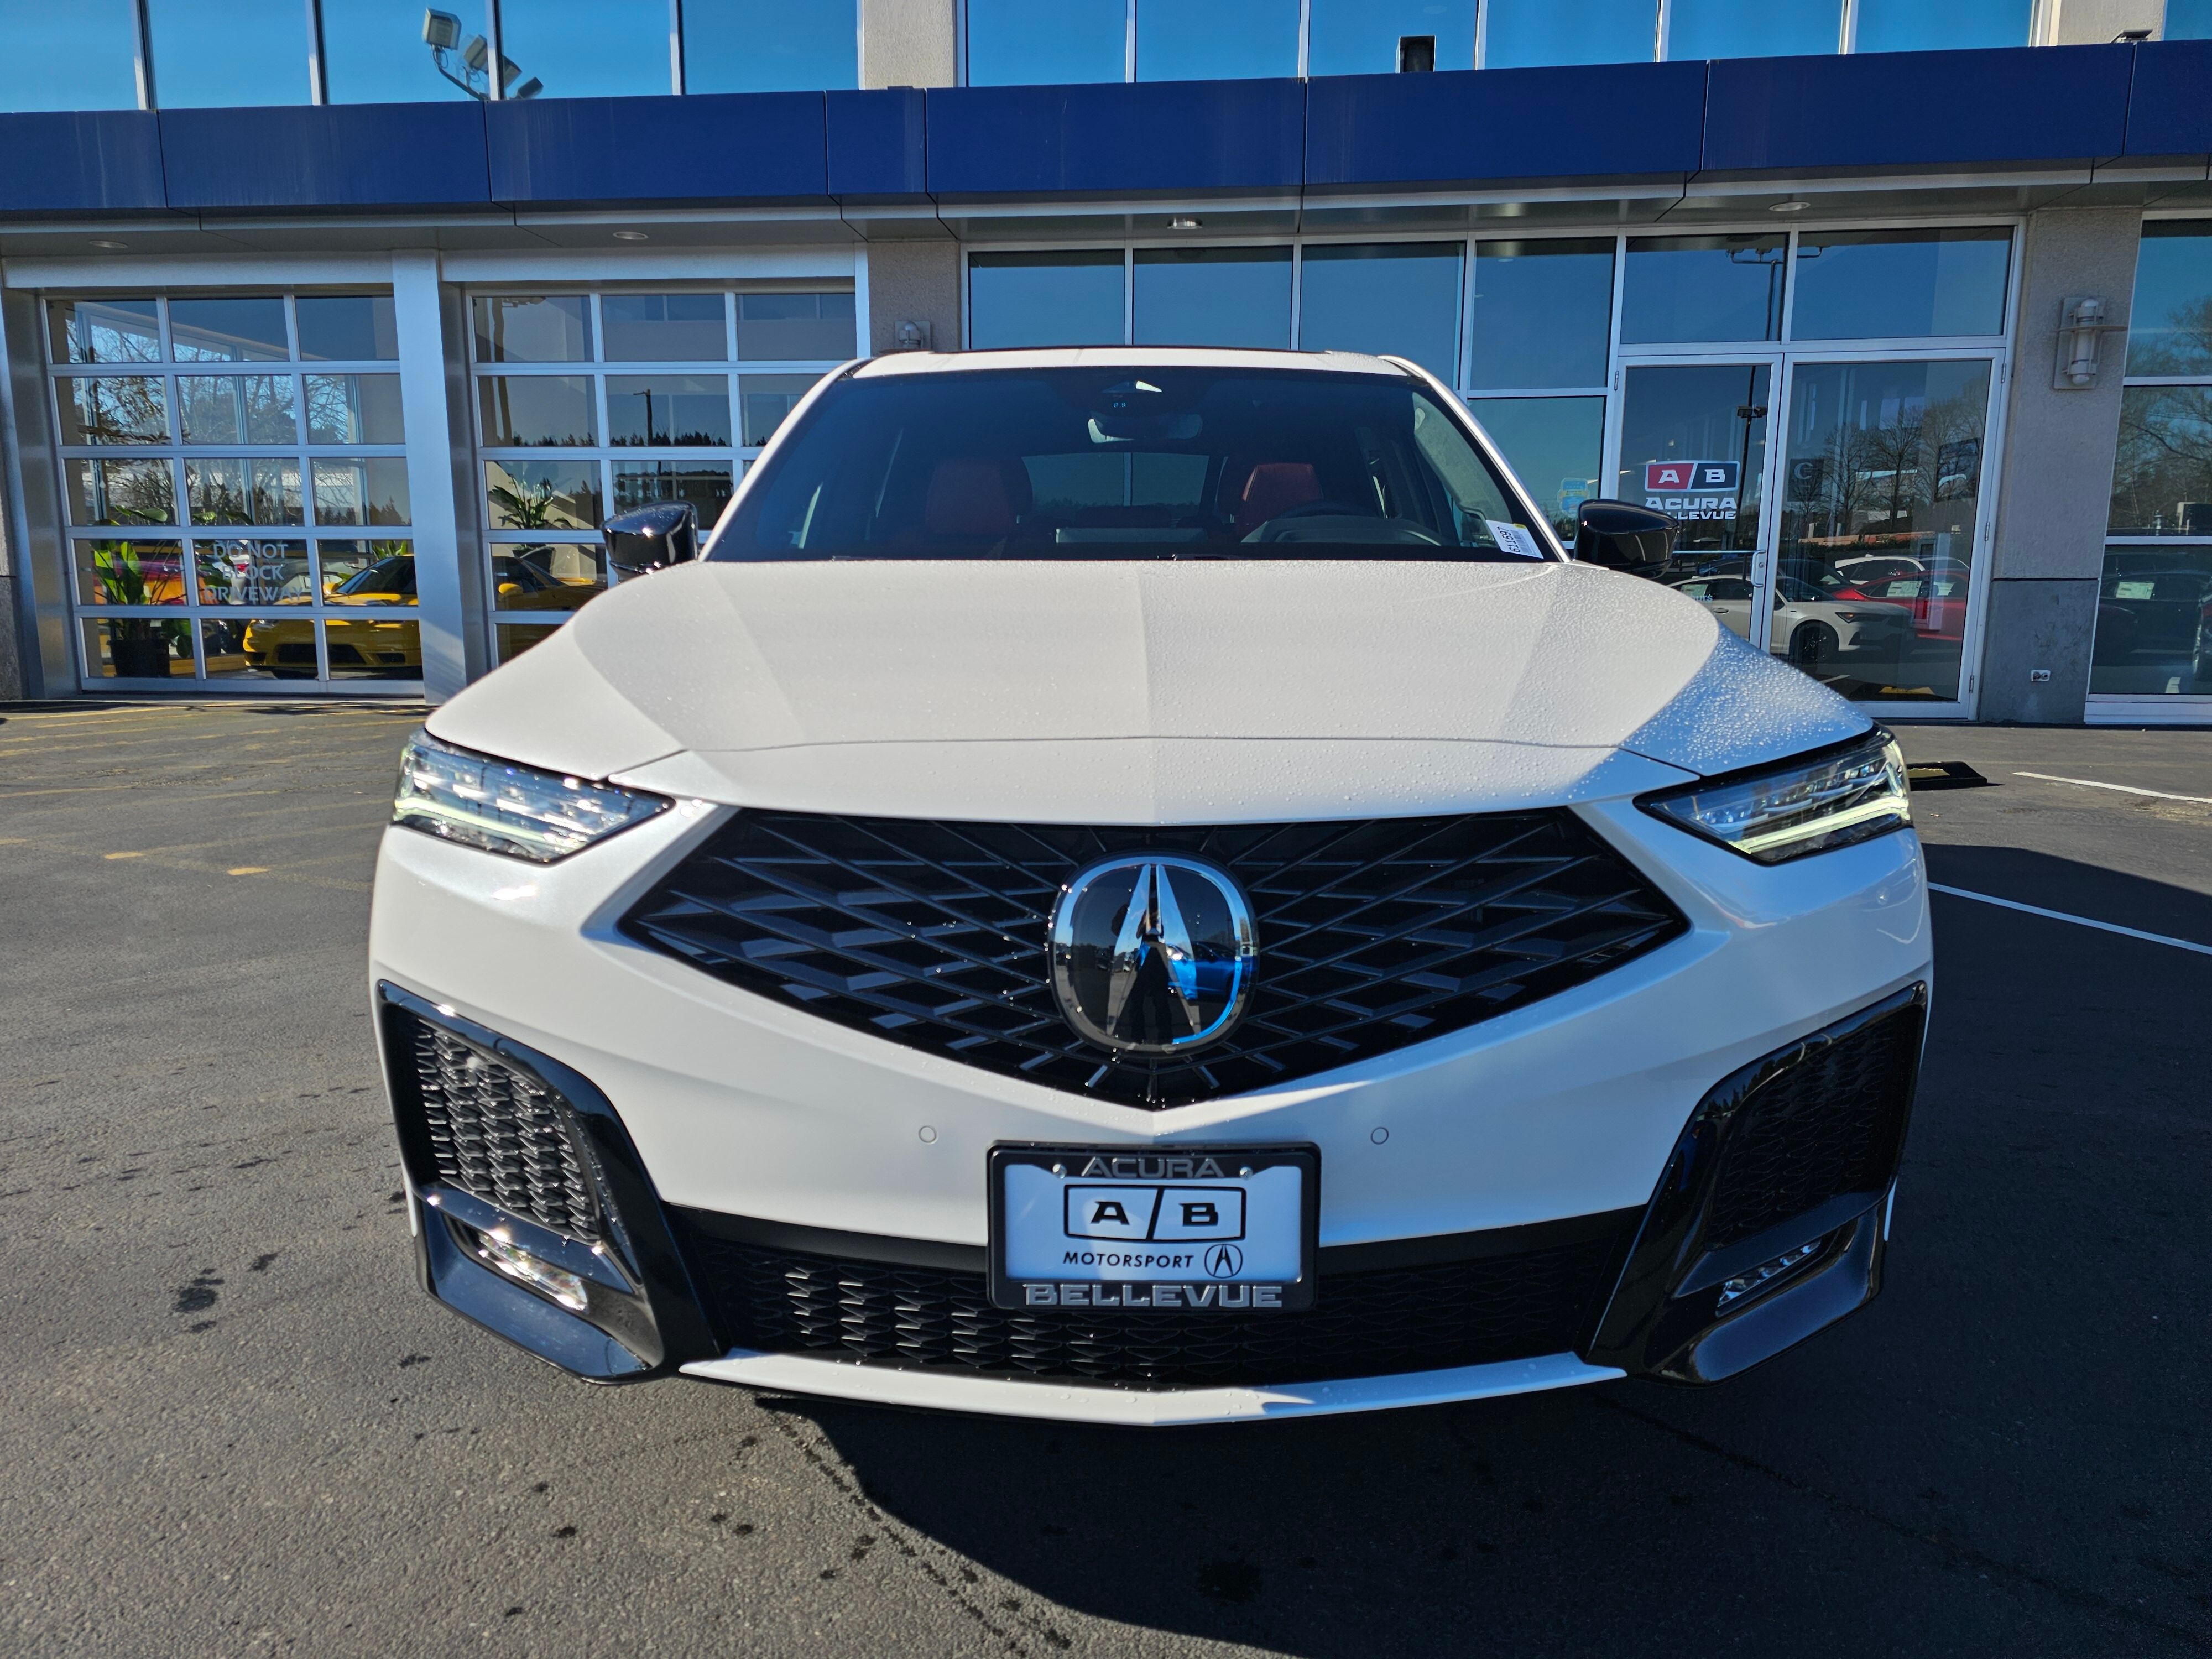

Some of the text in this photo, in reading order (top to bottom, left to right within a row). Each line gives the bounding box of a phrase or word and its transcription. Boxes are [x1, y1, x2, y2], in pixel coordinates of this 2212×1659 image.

[1658, 469, 1725, 483] A B
[1645, 497, 1737, 510] ACURA
[1497, 526, 1520, 552] 611597
[213, 544, 288, 559] DO NOT
[222, 565, 284, 580] BLOCK
[204, 586, 303, 601] DRIVEWAY
[1081, 1156, 1225, 1178] ACURA
[1091, 1201, 1219, 1227] A B
[1063, 1251, 1194, 1269] MOTORSPORT
[1022, 1283, 1282, 1308] BELLEVUE
